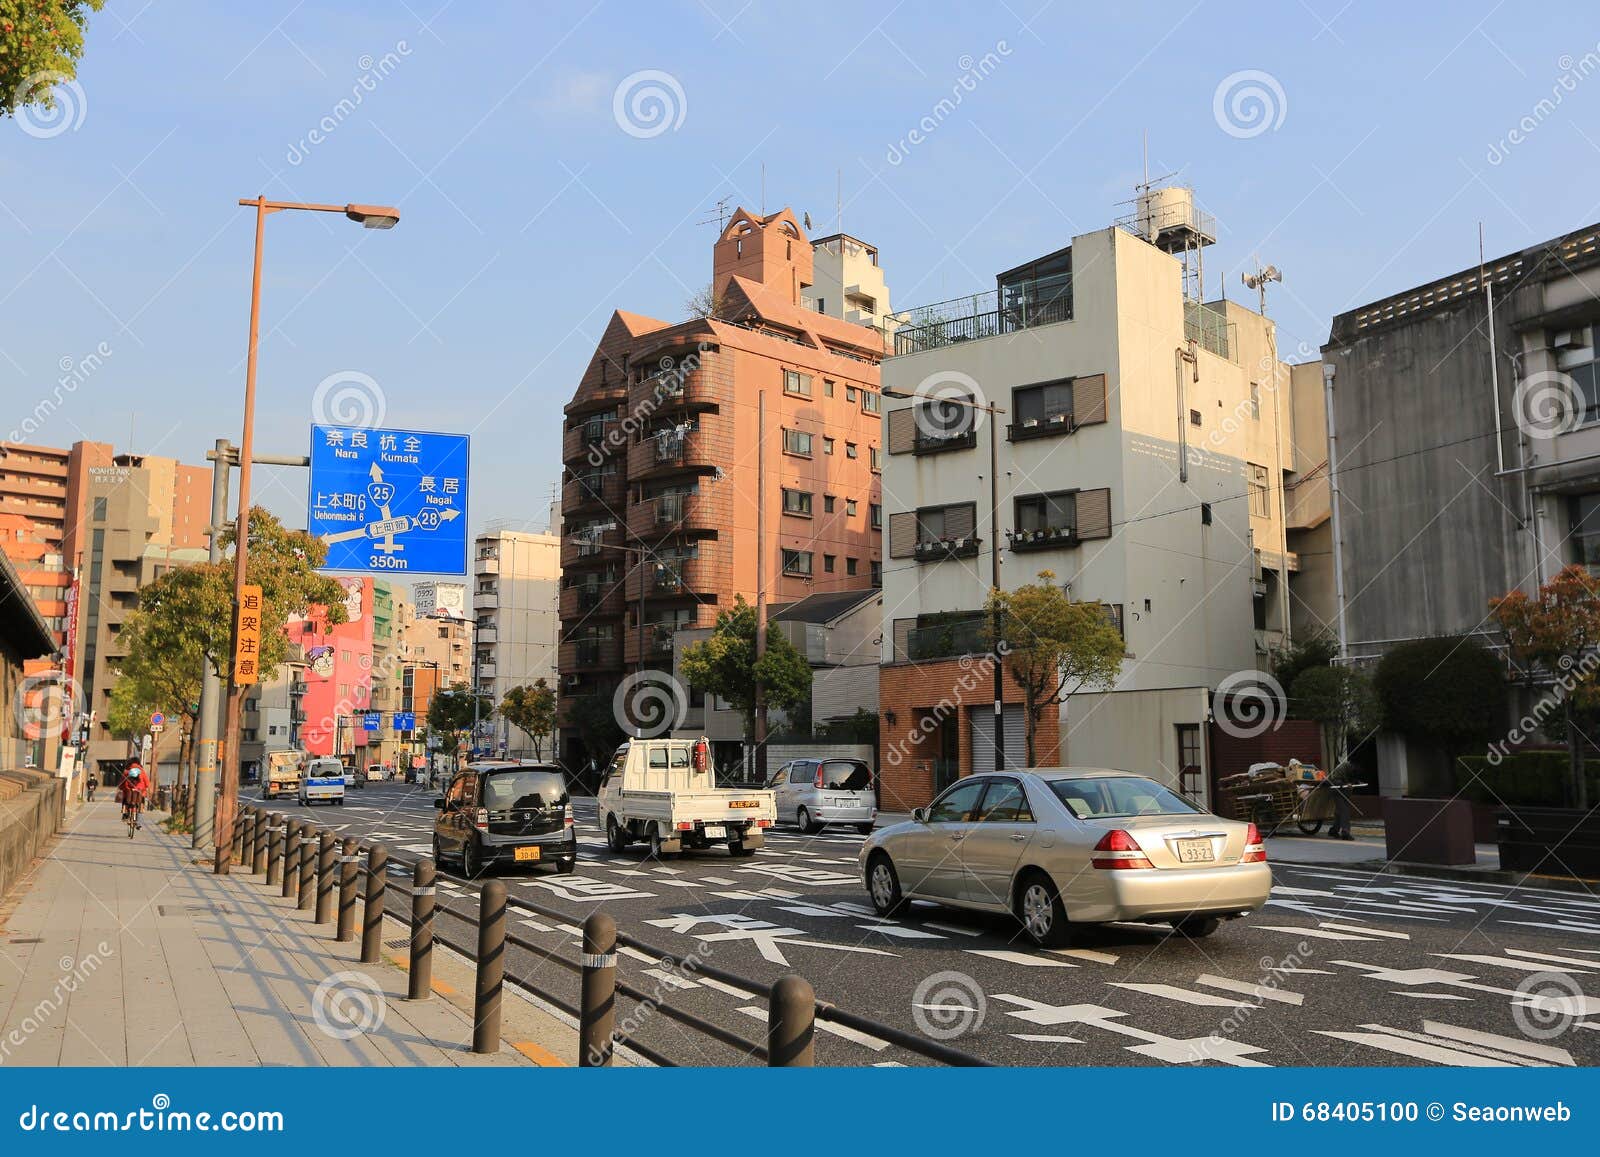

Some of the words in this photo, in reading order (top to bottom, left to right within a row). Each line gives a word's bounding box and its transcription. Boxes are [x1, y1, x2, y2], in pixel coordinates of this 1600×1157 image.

[326, 429, 368, 449] 奈良
[379, 434, 421, 453] 杭全
[335, 448, 358, 459] Nara
[381, 452, 419, 464] Kumata
[419, 476, 460, 494] 長居
[373, 487, 389, 500] 25
[313, 492, 366, 511] 上本町6
[426, 496, 452, 506] Nagai
[314, 510, 357, 522] Uehonmachi
[359, 513, 364, 522] 6
[421, 513, 438, 526] 28
[369, 556, 408, 569] 350m
[417, 589, 433, 598] クラウン
[239, 594, 258, 675] 追突注意
